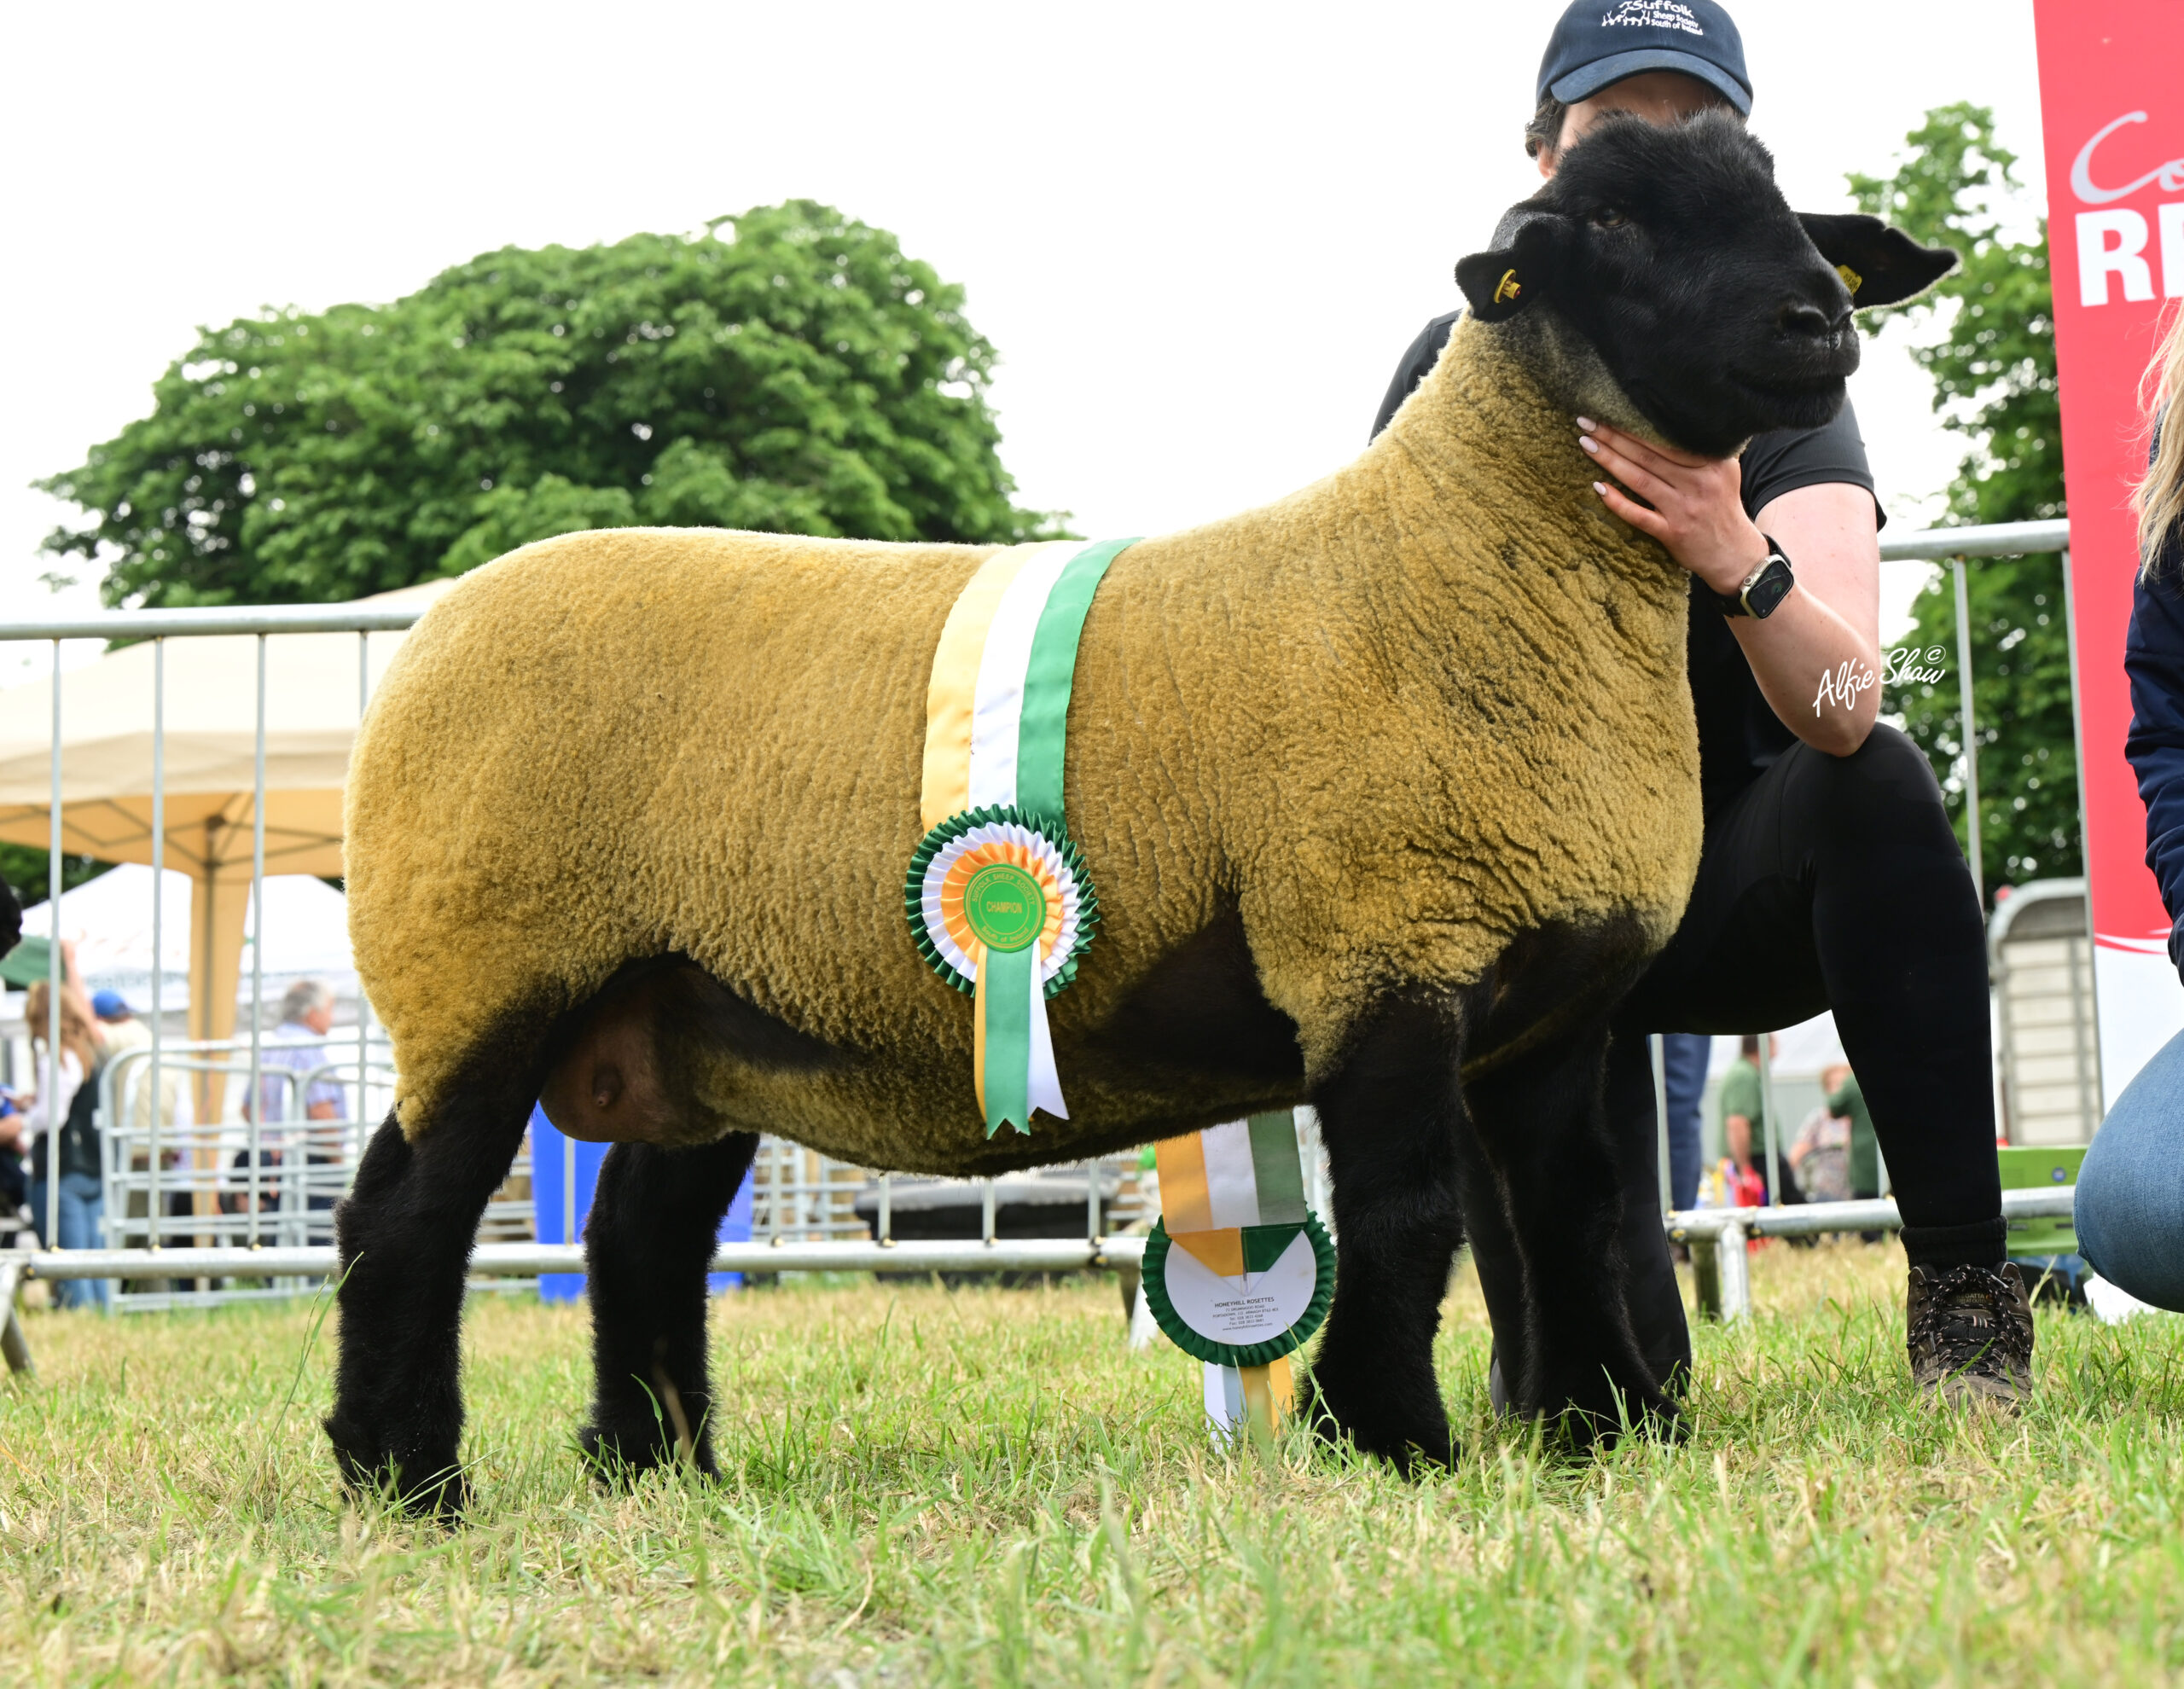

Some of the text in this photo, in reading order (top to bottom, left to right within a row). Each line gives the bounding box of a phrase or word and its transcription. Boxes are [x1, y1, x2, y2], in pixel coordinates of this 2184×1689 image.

[1630, 0, 1694, 18] Suffolk
[1651, 18, 1672, 28] South
[1653, 10, 1699, 28] Sheep Society
[972, 876, 991, 903] SUFFOLK
[1016, 879, 1037, 905] SOCIETY
[986, 901, 1023, 914] CHAMPION
[1214, 1300, 1246, 1309] HONEYHILL
